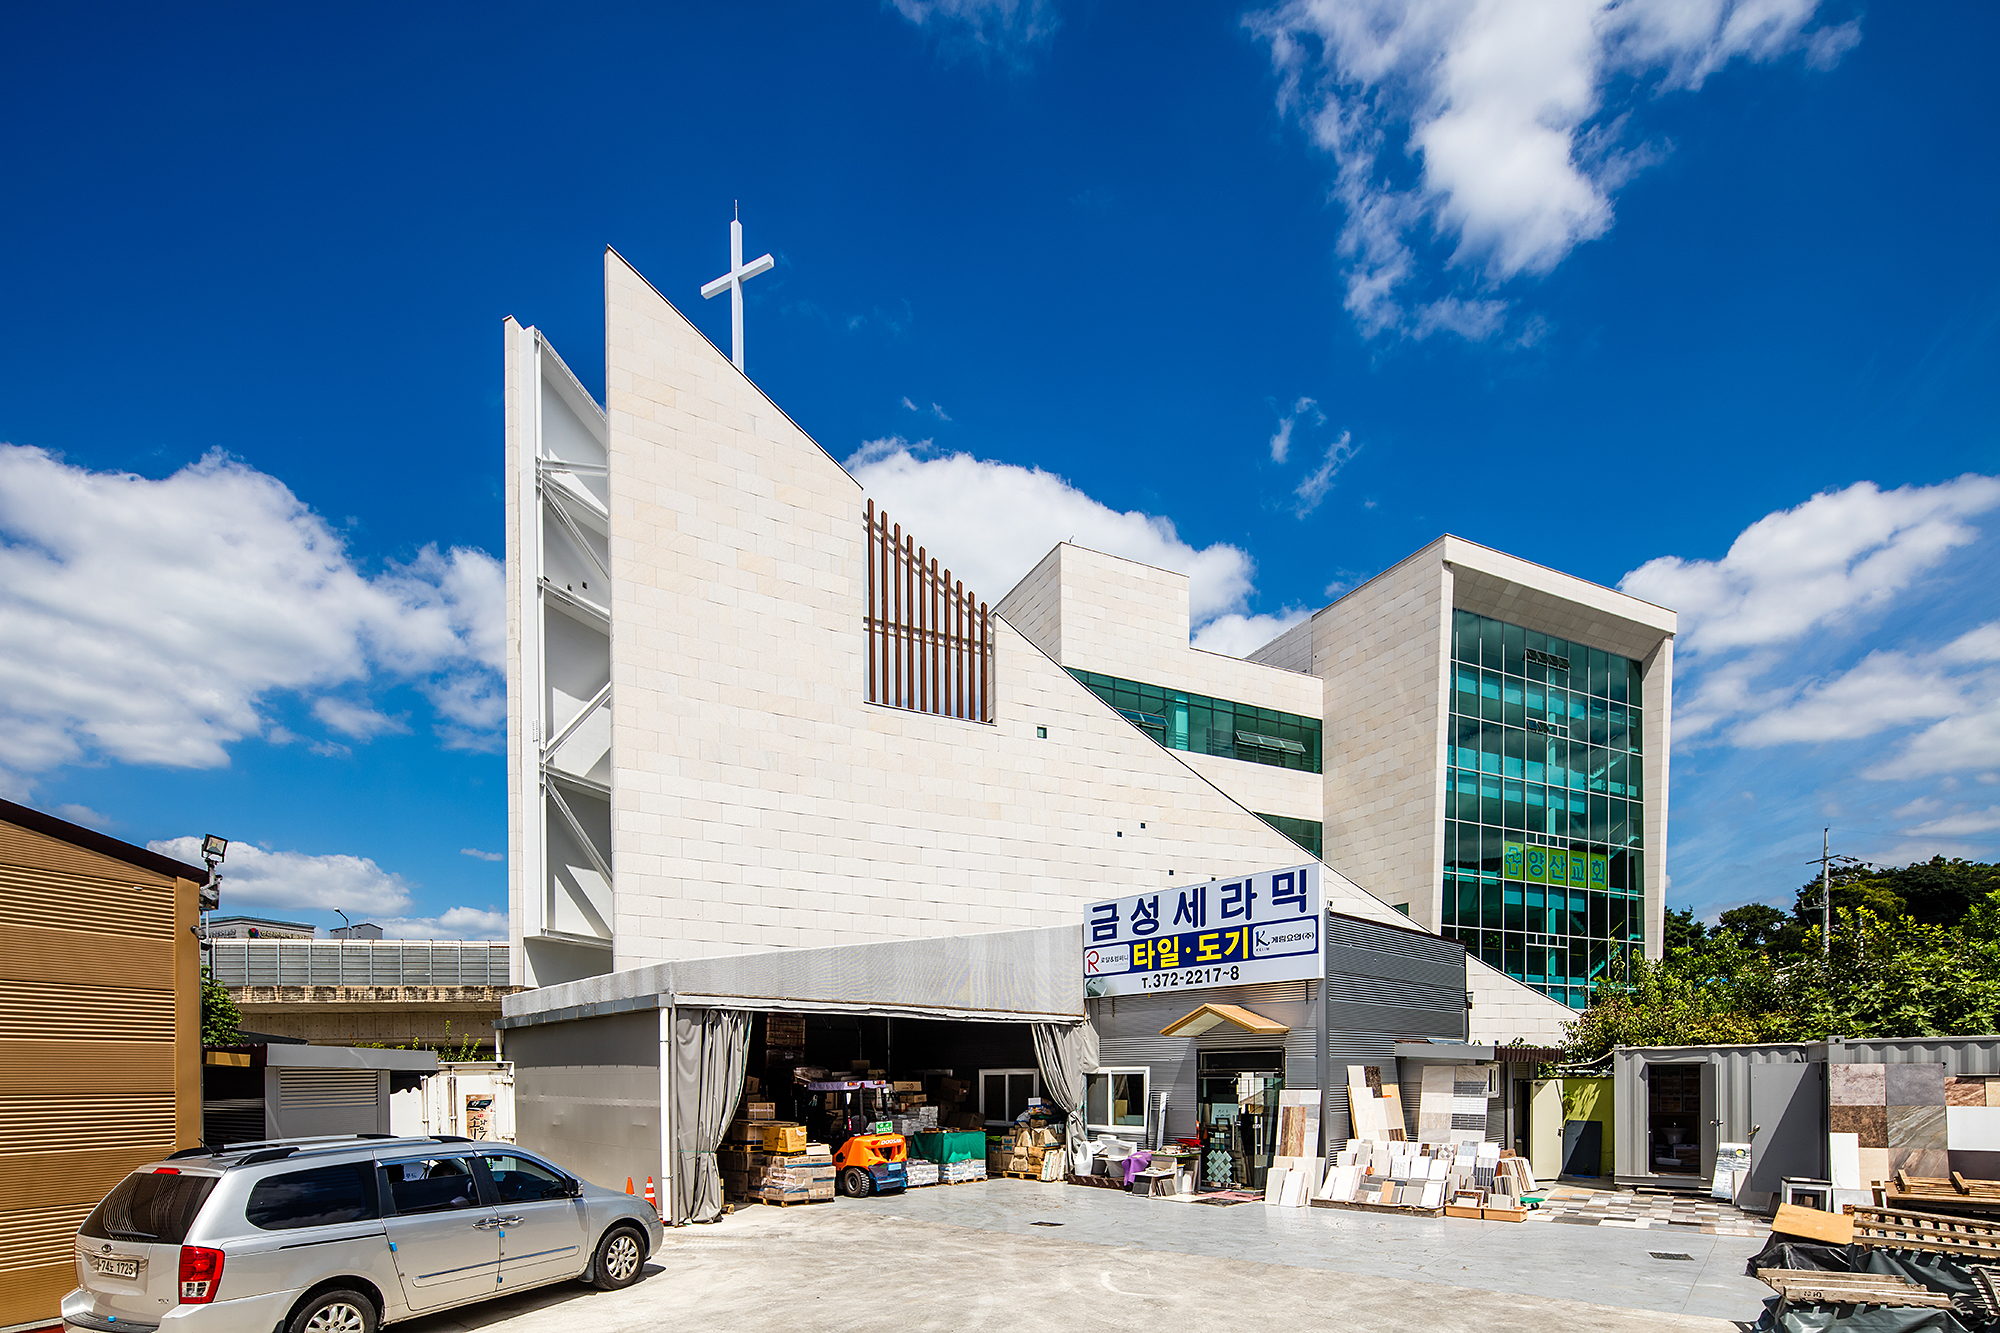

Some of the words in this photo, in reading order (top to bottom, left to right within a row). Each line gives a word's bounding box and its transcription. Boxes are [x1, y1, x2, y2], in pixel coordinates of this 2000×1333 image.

[1528, 850, 1606, 885] 양산교회
[1090, 868, 1307, 942] 금성세라믹
[1133, 926, 1249, 970] 타일·도기
[1141, 965, 1240, 989] T.372-2217~8
[116, 1262, 133, 1275] 1725
